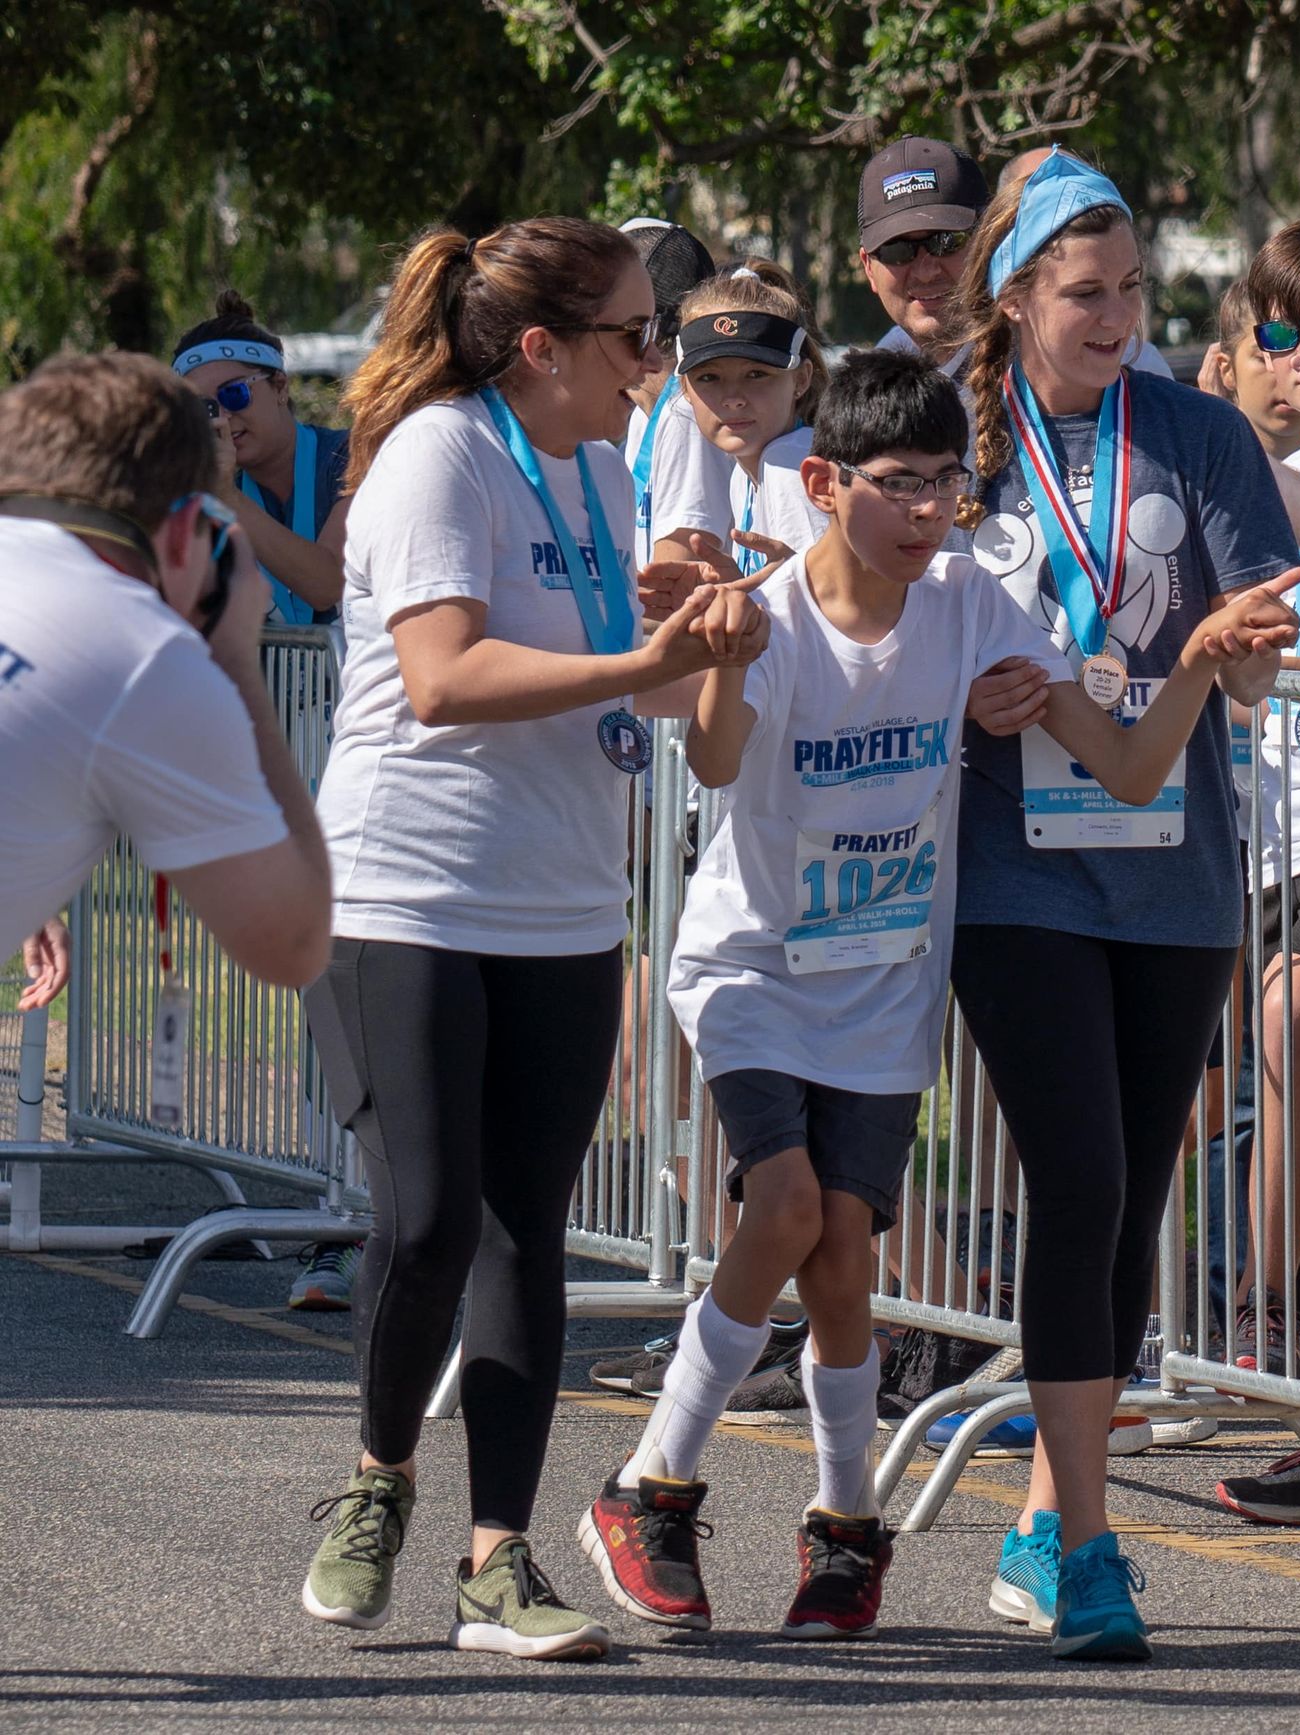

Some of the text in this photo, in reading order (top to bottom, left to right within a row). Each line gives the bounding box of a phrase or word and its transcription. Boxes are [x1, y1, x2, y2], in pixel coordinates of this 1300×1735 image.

[886, 181, 934, 200] patagonia
[1167, 554, 1183, 609] enrich
[906, 716, 918, 724] CA
[915, 717, 949, 770] 5K
[1072, 791, 1103, 800] 1-MILE
[1082, 801, 1103, 809] APRIL
[832, 822, 920, 853] PRAYFIT
[1159, 832, 1171, 844] 54
[801, 840, 937, 921] 1026
[859, 906, 919, 919] WALK-N-ROLL
[838, 923, 857, 932] APRIL
